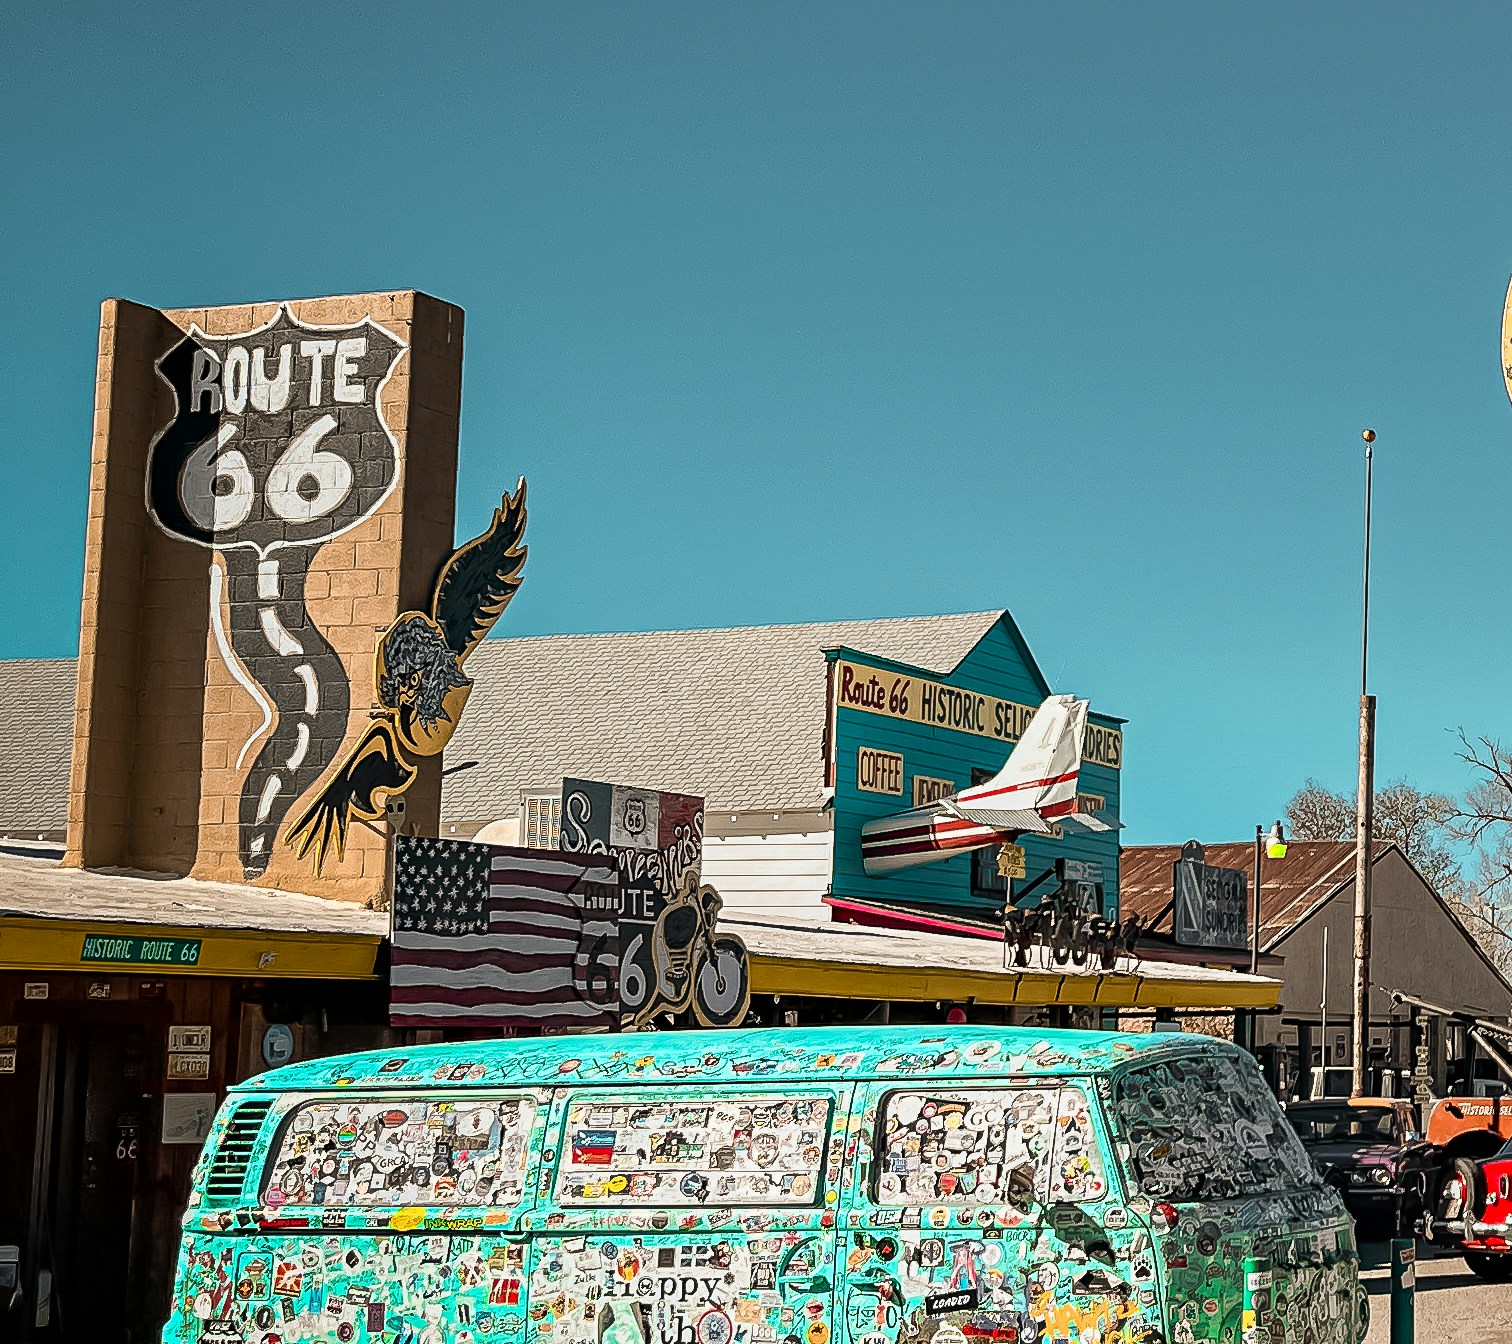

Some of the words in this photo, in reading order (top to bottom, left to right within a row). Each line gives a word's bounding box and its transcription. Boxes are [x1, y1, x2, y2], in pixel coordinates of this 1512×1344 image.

[190, 337, 367, 415] ROUTE
[180, 414, 353, 532] 66
[840, 665, 886, 710] Route
[888, 677, 911, 715] 66
[921, 682, 985, 732] HISTORIC
[993, 701, 1037, 739] SELIG
[860, 750, 902, 792] COFFEE
[627, 813, 642, 827] 66
[83, 939, 134, 959] HISTORIC
[140, 942, 175, 961] ROUTE
[180, 943, 198, 962] 66
